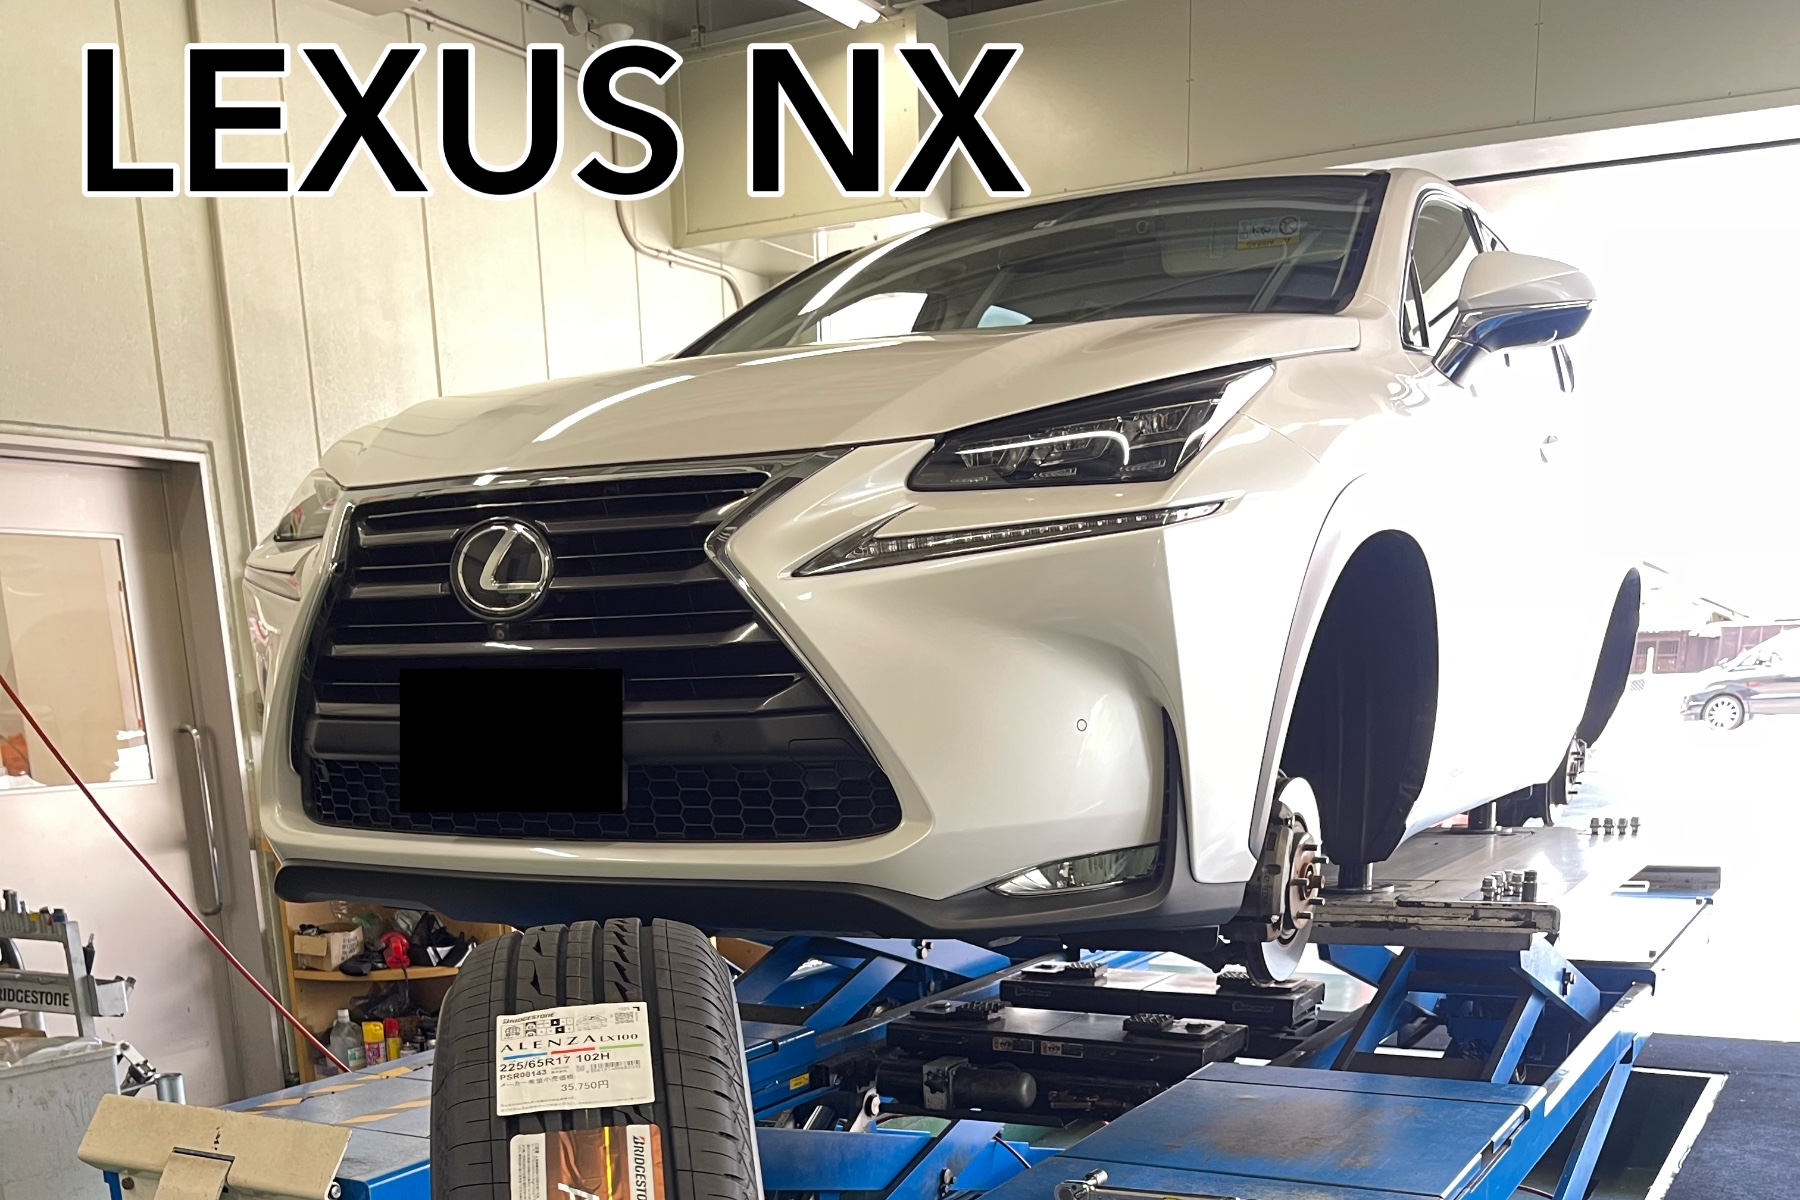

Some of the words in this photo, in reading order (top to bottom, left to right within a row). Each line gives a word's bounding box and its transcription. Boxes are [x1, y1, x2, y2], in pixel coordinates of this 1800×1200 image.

[500, 1034, 597, 1053] ALENZA
[599, 1033, 639, 1043] LX100
[499, 1056, 571, 1073] 225/65R17
[576, 1052, 611, 1062] 102H
[499, 1069, 548, 1081] PSR08143
